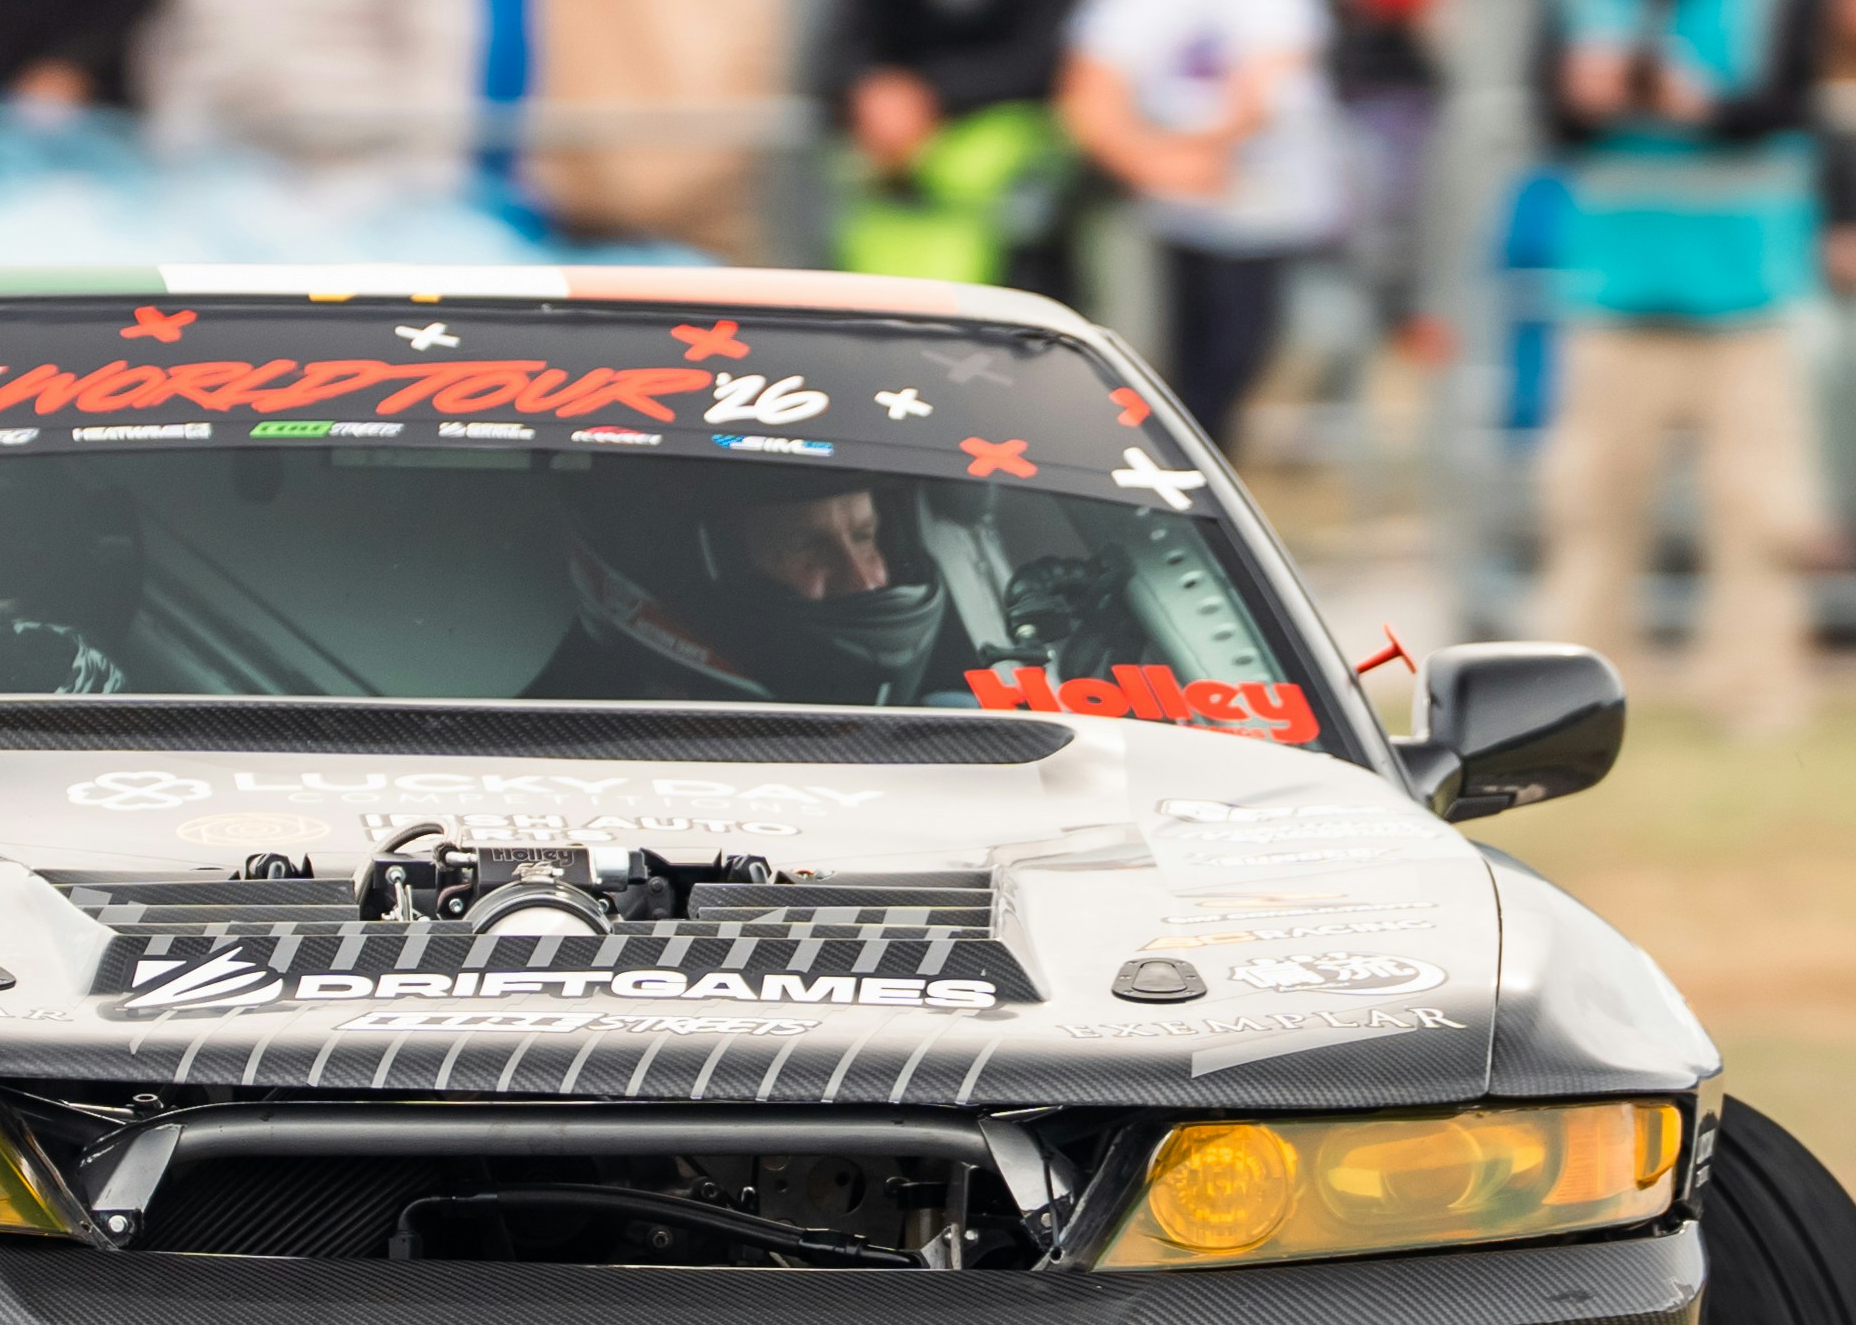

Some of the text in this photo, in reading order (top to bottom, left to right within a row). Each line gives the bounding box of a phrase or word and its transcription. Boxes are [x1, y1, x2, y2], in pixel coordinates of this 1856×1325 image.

[363, 359, 713, 423] TOUR
[964, 664, 1320, 744] Holley
[234, 773, 886, 807] LUCKY DAY
[288, 792, 827, 817] COMPETITIONS
[586, 816, 802, 836] AUTO
[491, 848, 575, 866] Holley
[294, 968, 998, 1009] DRIFTGAMES
[1056, 1006, 1468, 1039] EXEMPLAR
